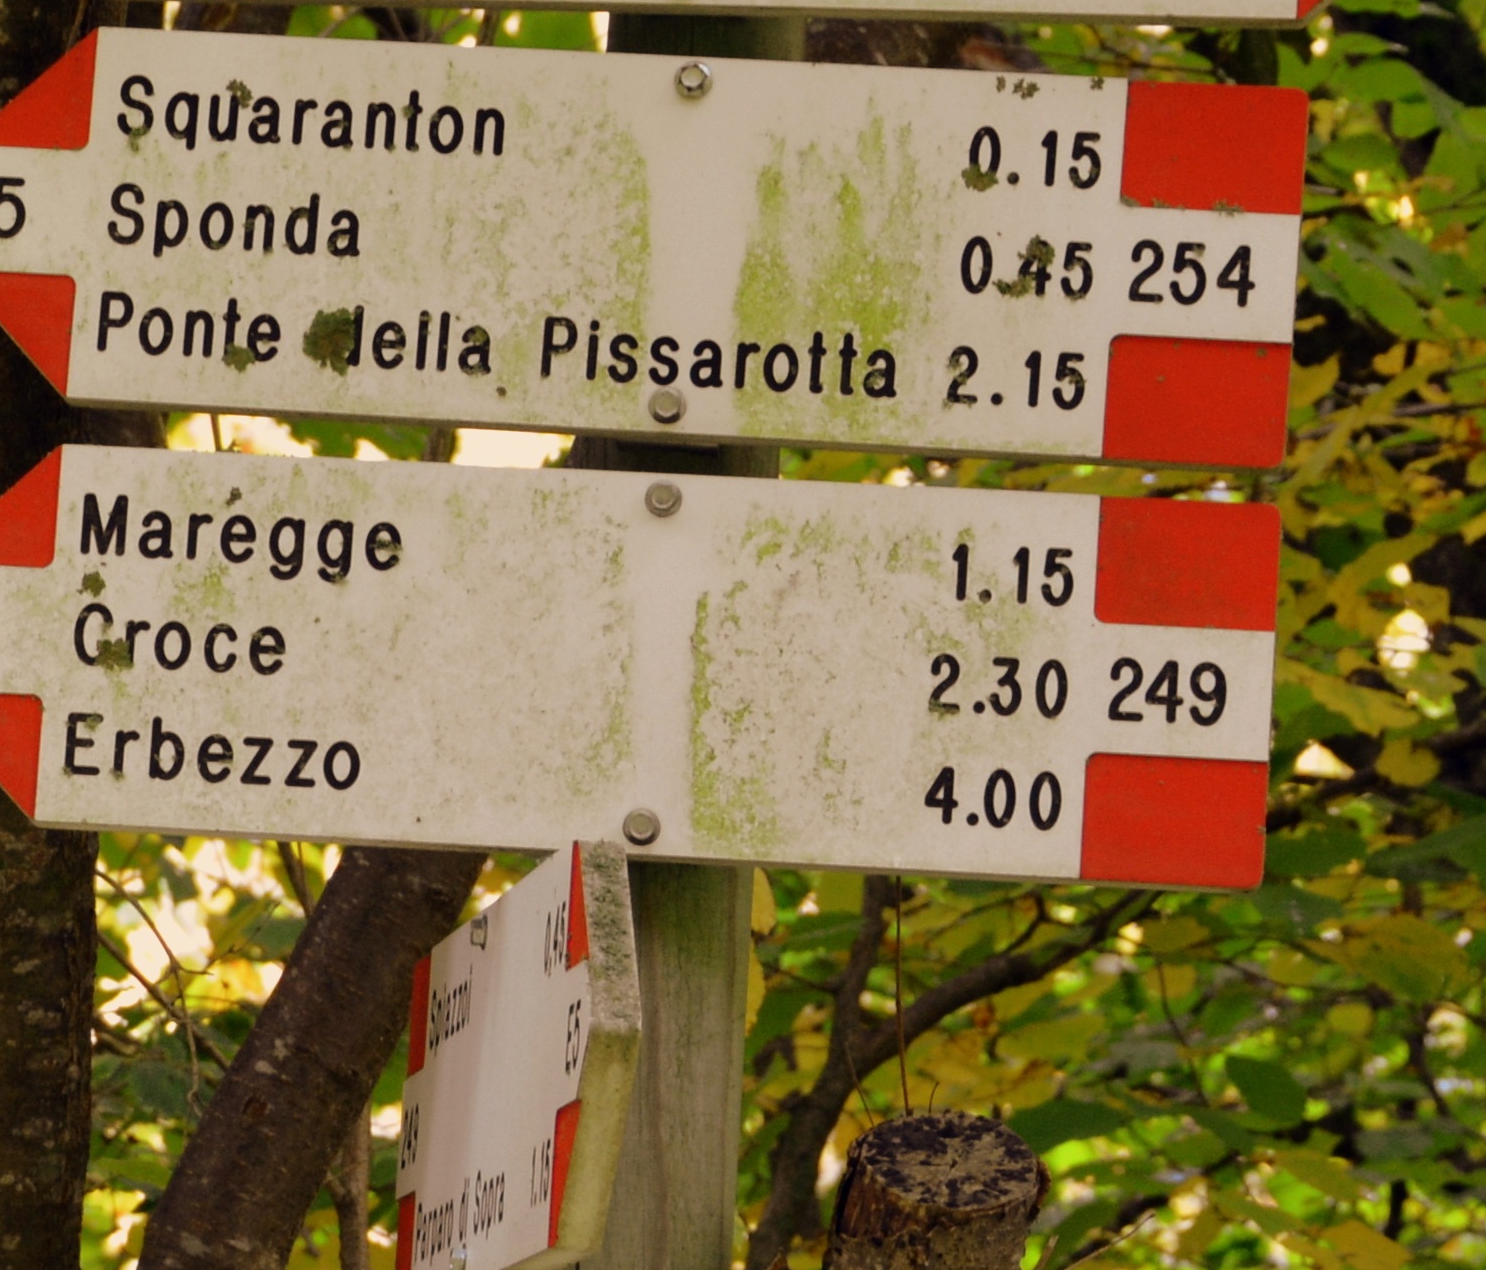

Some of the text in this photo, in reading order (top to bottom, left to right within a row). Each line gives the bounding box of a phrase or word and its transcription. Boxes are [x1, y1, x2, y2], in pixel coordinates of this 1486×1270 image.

[116, 76, 1102, 191] Squaranton 0.15
[107, 184, 360, 258] Sponda
[1128, 239, 1256, 307] 254
[97, 291, 281, 365] Ponte
[540, 316, 898, 399] Pissarotta
[947, 346, 1086, 411] 2.15
[80, 492, 1074, 607] Maregge 1.15
[73, 602, 1068, 719] Croce 2.30
[1107, 658, 1227, 726] 249
[64, 713, 1063, 832] Erbezzo 4.00
[565, 999, 581, 1074] E5
[400, 1103, 420, 1169] 249
[473, 1170, 506, 1241] Sopra
